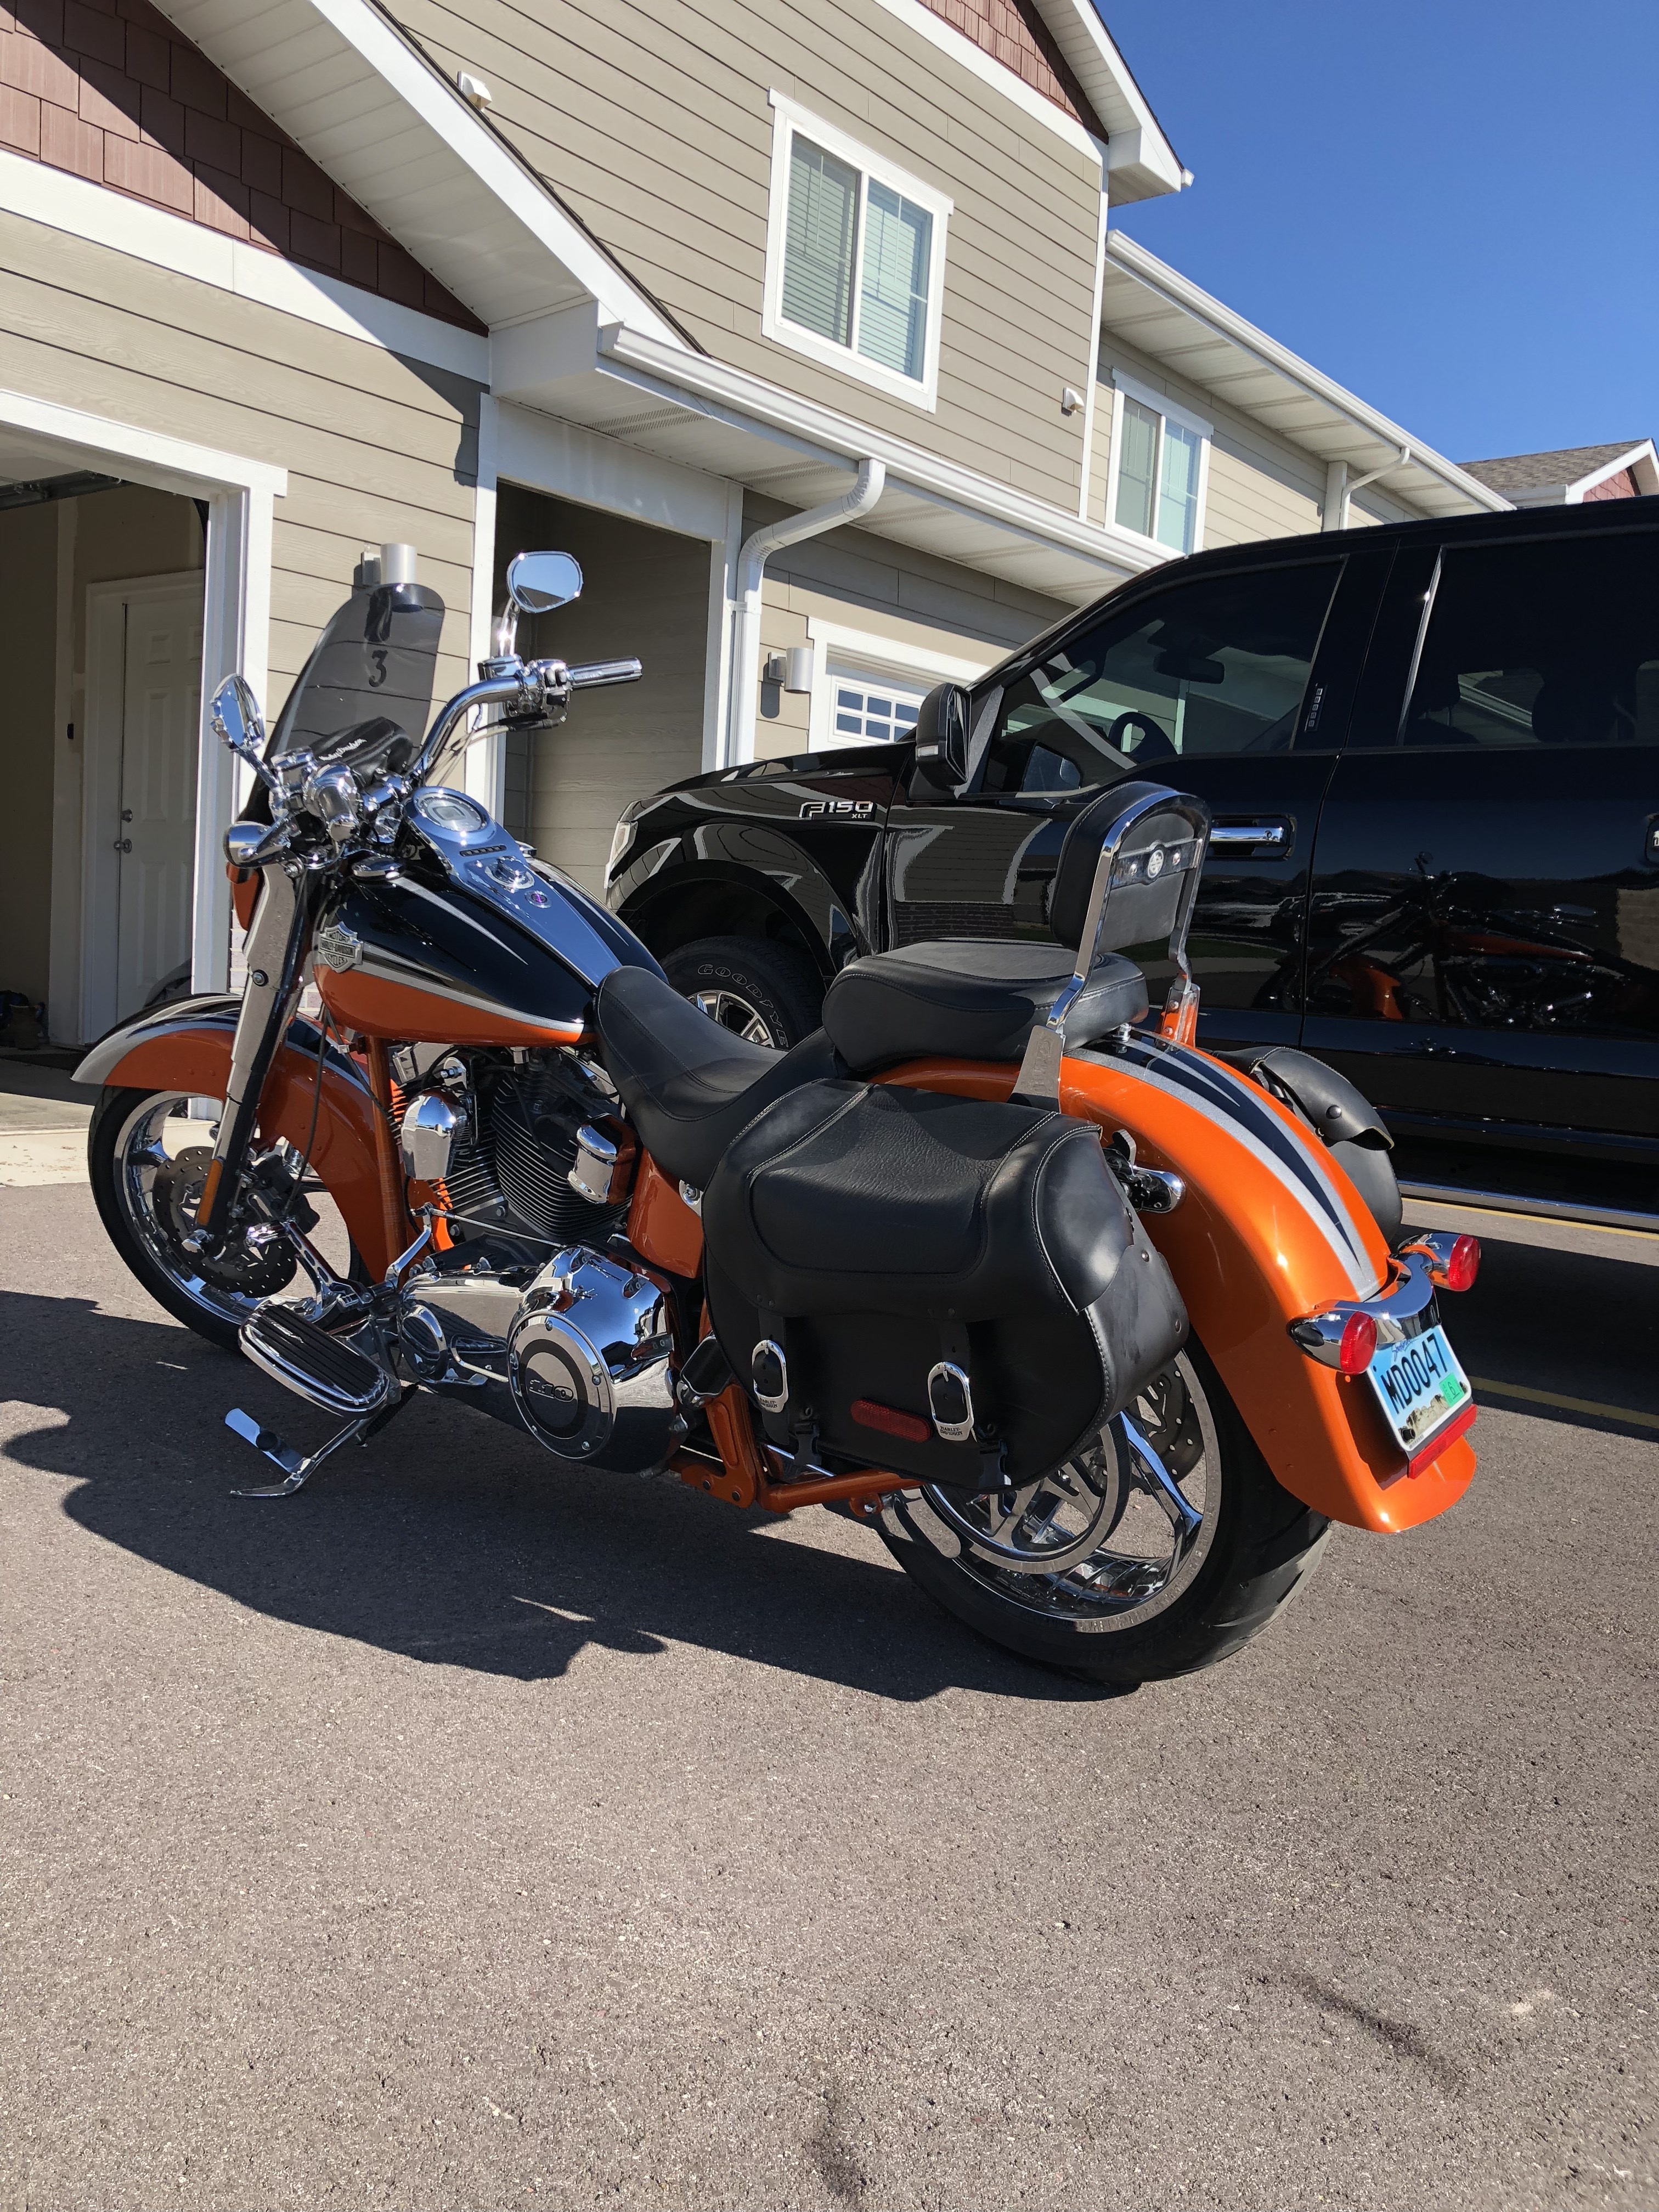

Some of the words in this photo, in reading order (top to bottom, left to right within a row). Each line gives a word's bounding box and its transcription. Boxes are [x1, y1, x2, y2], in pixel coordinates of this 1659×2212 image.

[369, 650, 388, 687] 3
[697, 964, 789, 1048] GOODYE
[529, 1379, 574, 1402] 110
[1380, 1333, 1448, 1415] MD0047
